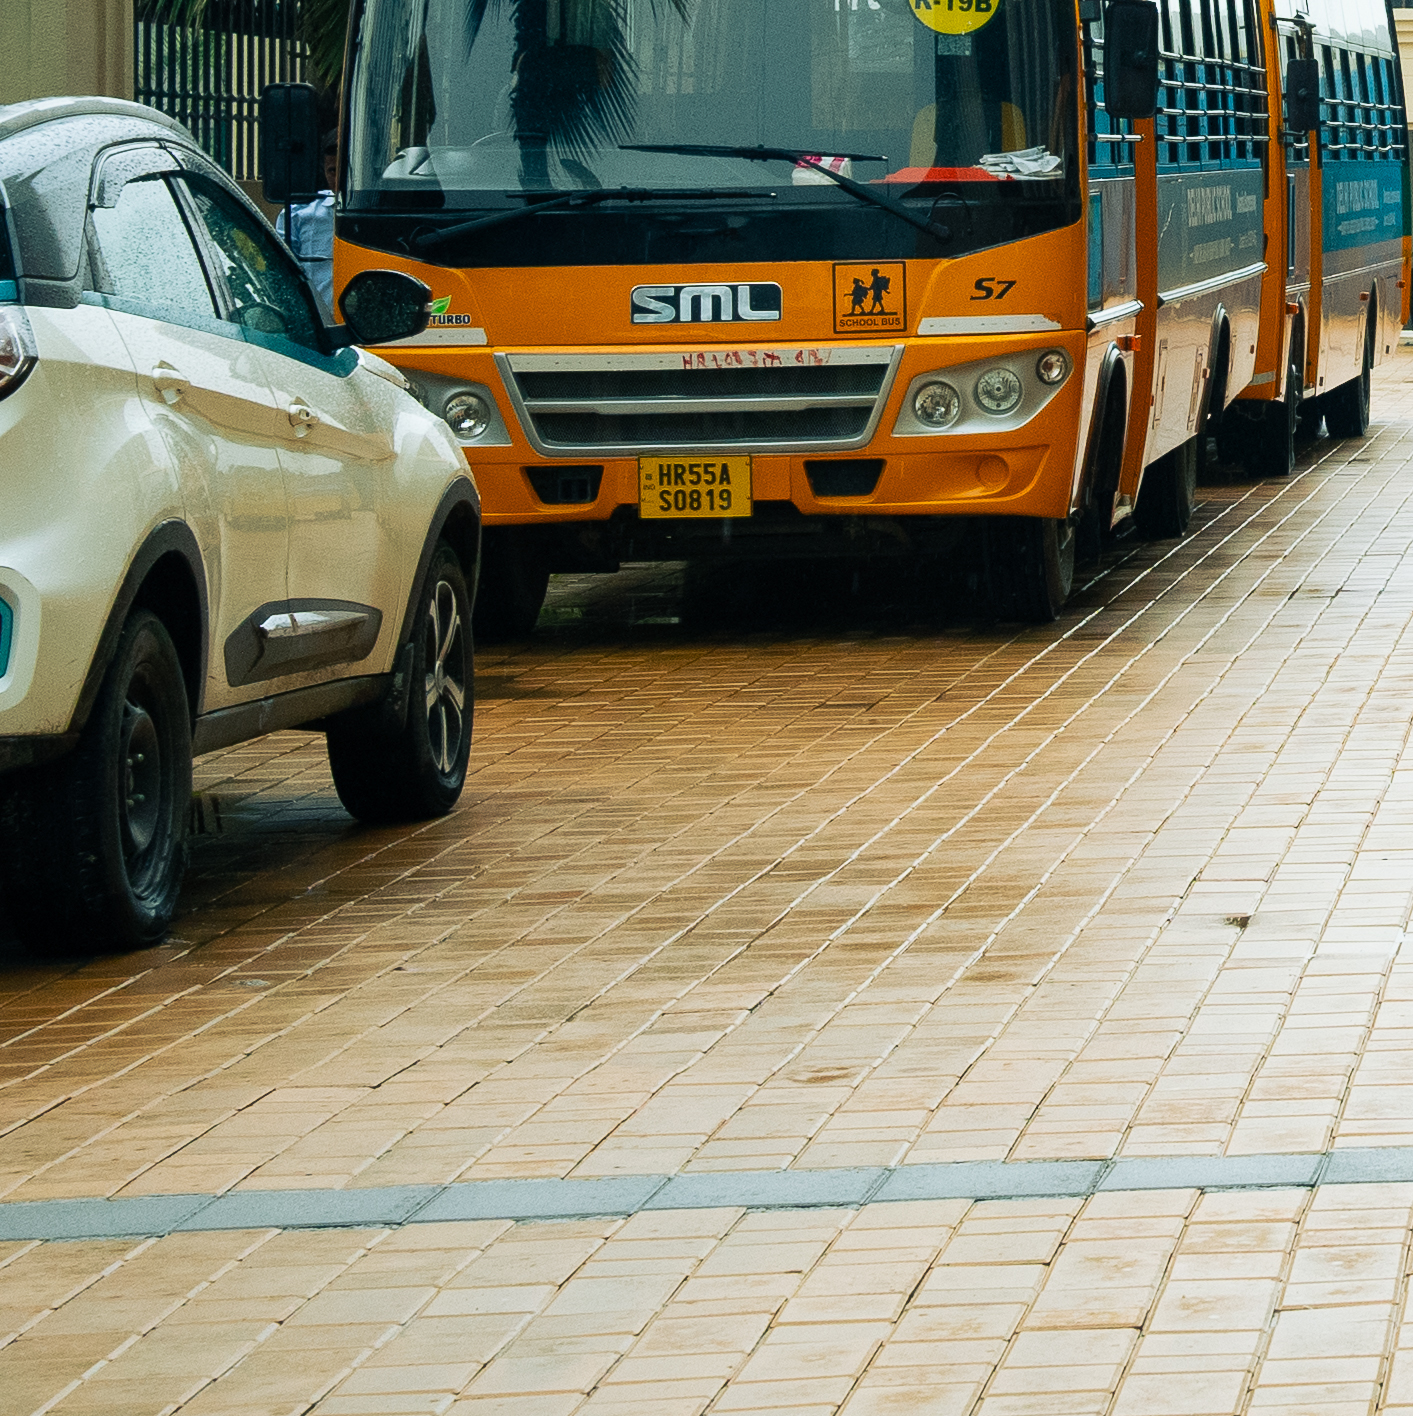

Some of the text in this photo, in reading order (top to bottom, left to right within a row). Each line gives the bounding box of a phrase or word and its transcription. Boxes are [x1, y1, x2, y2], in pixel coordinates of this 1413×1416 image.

[969, 277, 1017, 301] S7
[632, 285, 780, 324] SML
[430, 314, 471, 325] TURBO
[839, 317, 901, 328] SCHOOL BUS
[658, 462, 731, 486] HR55A
[659, 488, 732, 512] S0819
